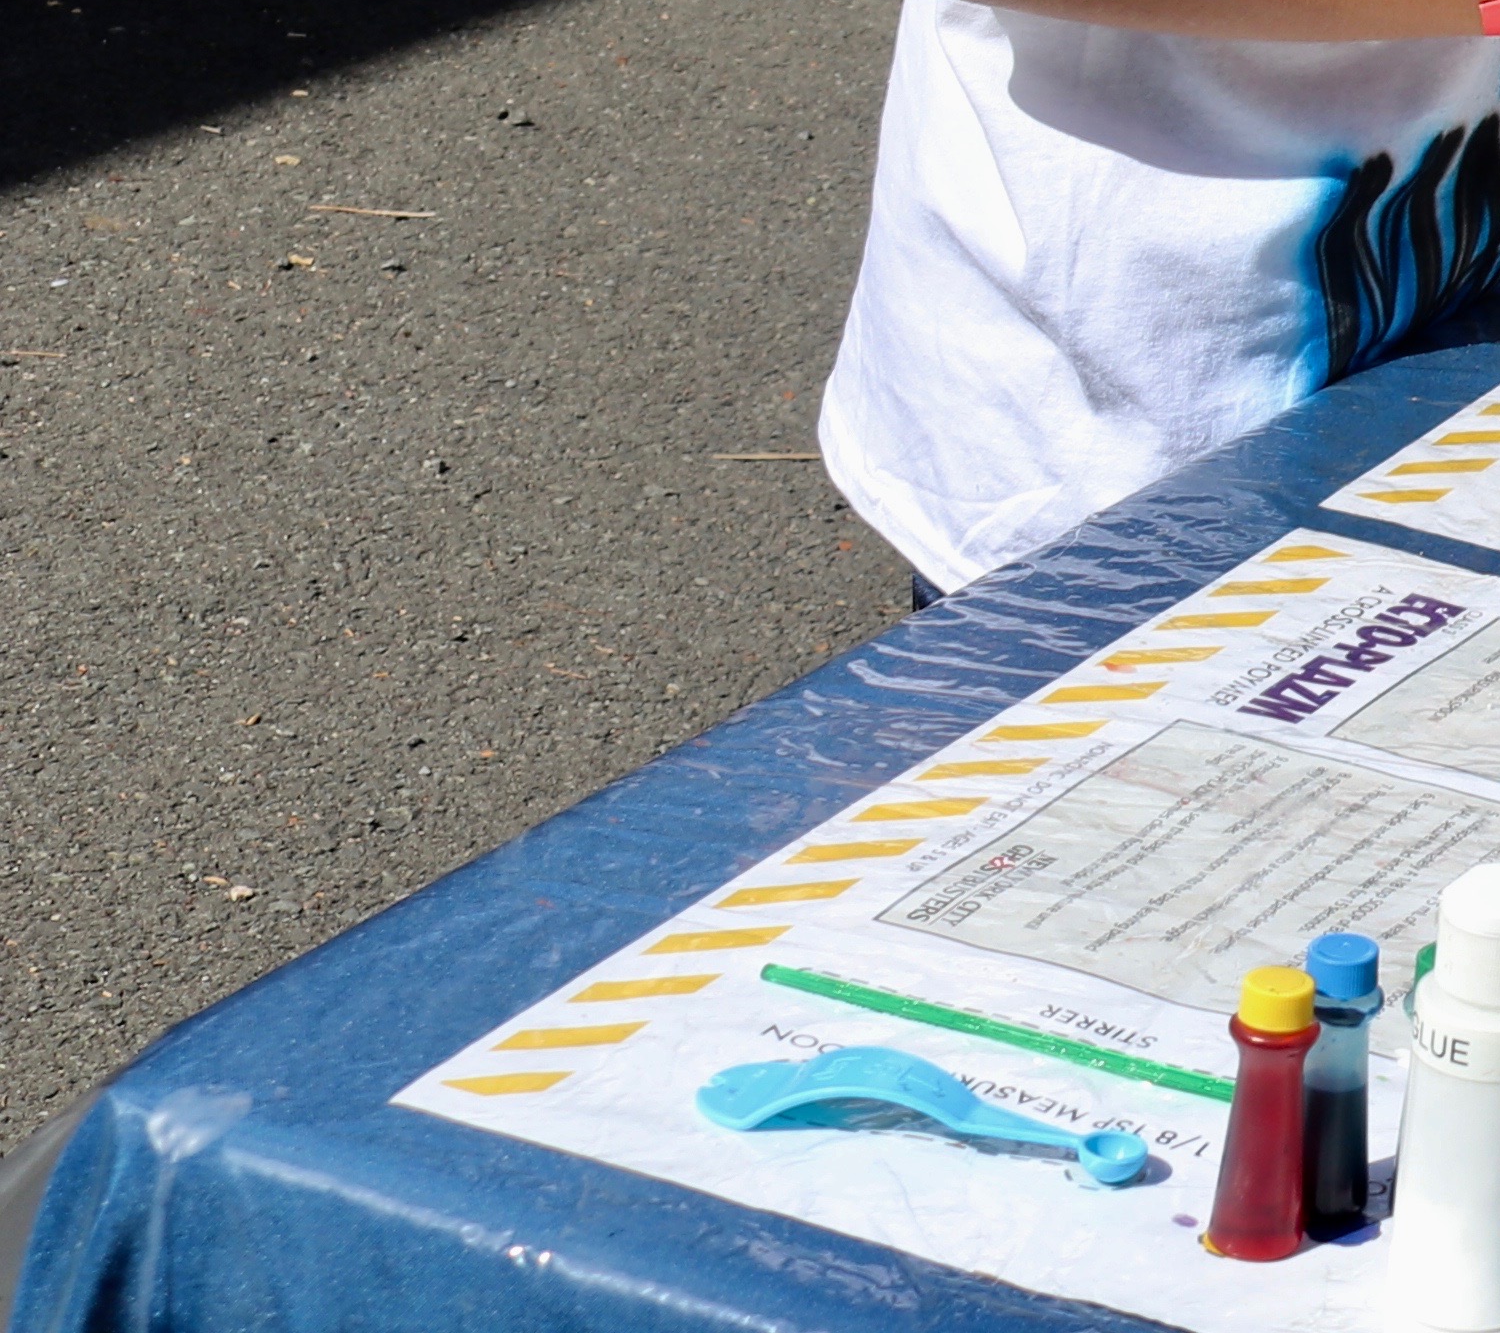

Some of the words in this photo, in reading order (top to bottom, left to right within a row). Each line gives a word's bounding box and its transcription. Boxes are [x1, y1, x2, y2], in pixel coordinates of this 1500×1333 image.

[1374, 584, 1395, 596] A
[1237, 593, 1468, 725] ECTO-PLAZM
[974, 873, 1026, 901] YORK
[936, 900, 987, 927] CITY
[1037, 1003, 1160, 1050] STIRRER
